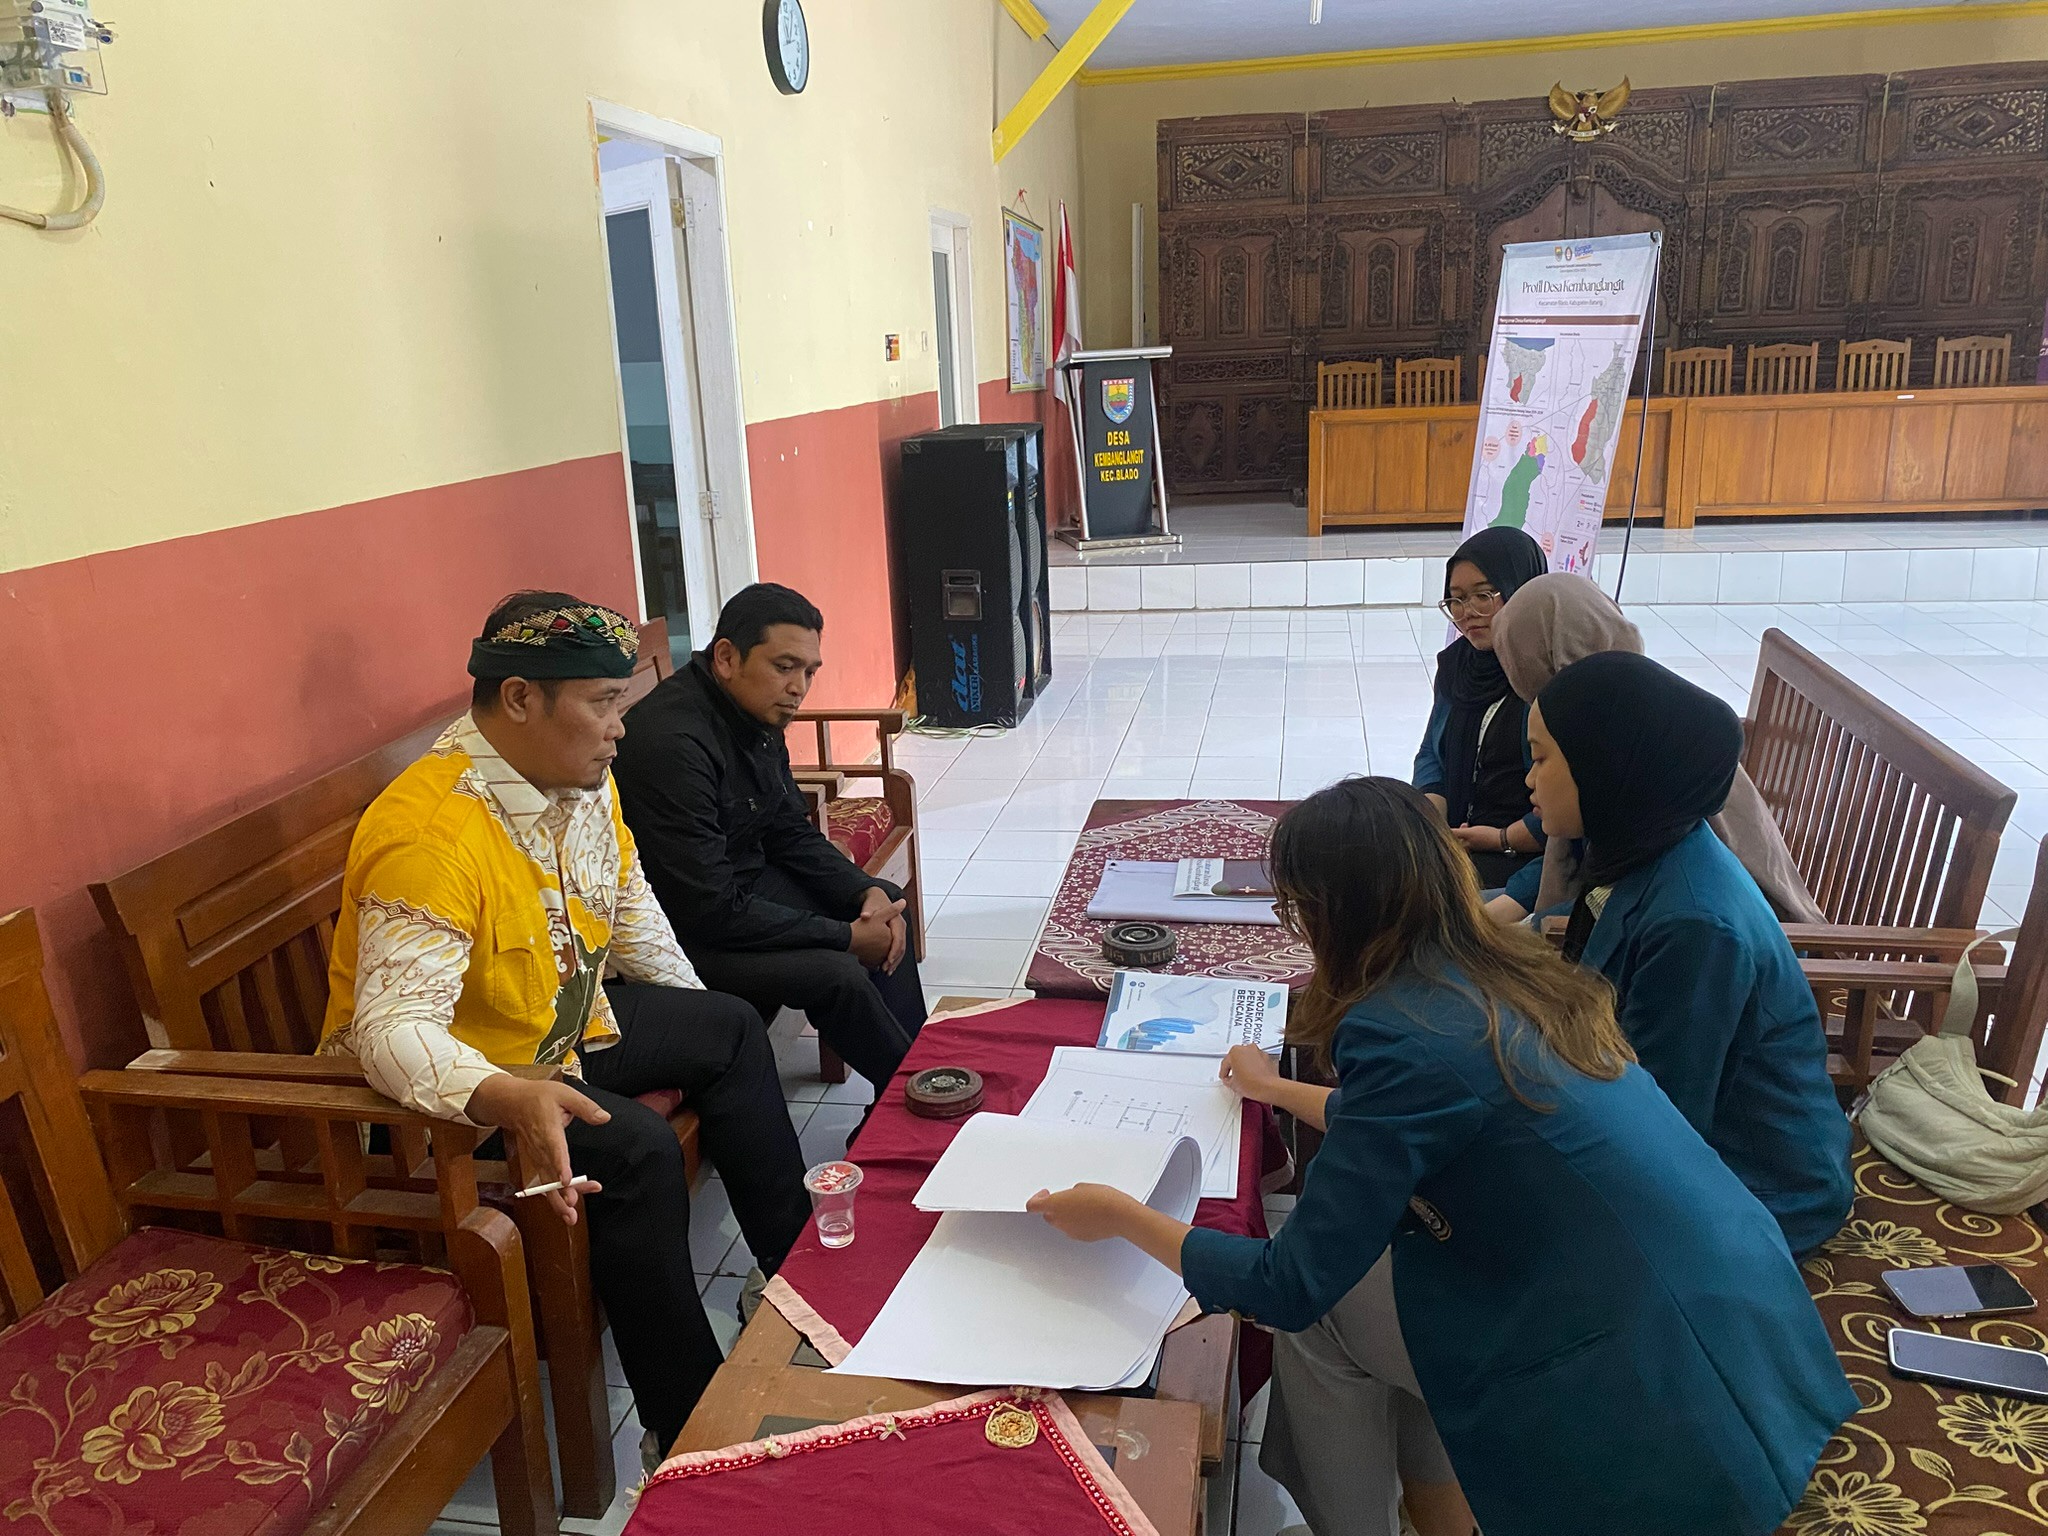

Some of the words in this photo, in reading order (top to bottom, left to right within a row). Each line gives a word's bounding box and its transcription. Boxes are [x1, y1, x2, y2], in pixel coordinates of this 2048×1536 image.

[1522, 279, 1543, 293] Profil
[1543, 281, 1562, 293] Desa
[1563, 278, 1624, 295] Kembanglangit
[1108, 431, 1129, 446] DESA
[1094, 449, 1144, 467] KEMBANGLANGIT
[1100, 468, 1139, 482] KEC.BLADO
[1234, 989, 1246, 1027] BENCANA
[1254, 991, 1265, 1022] PROJEK
[1242, 990, 1256, 1046] PENANGGULAN
